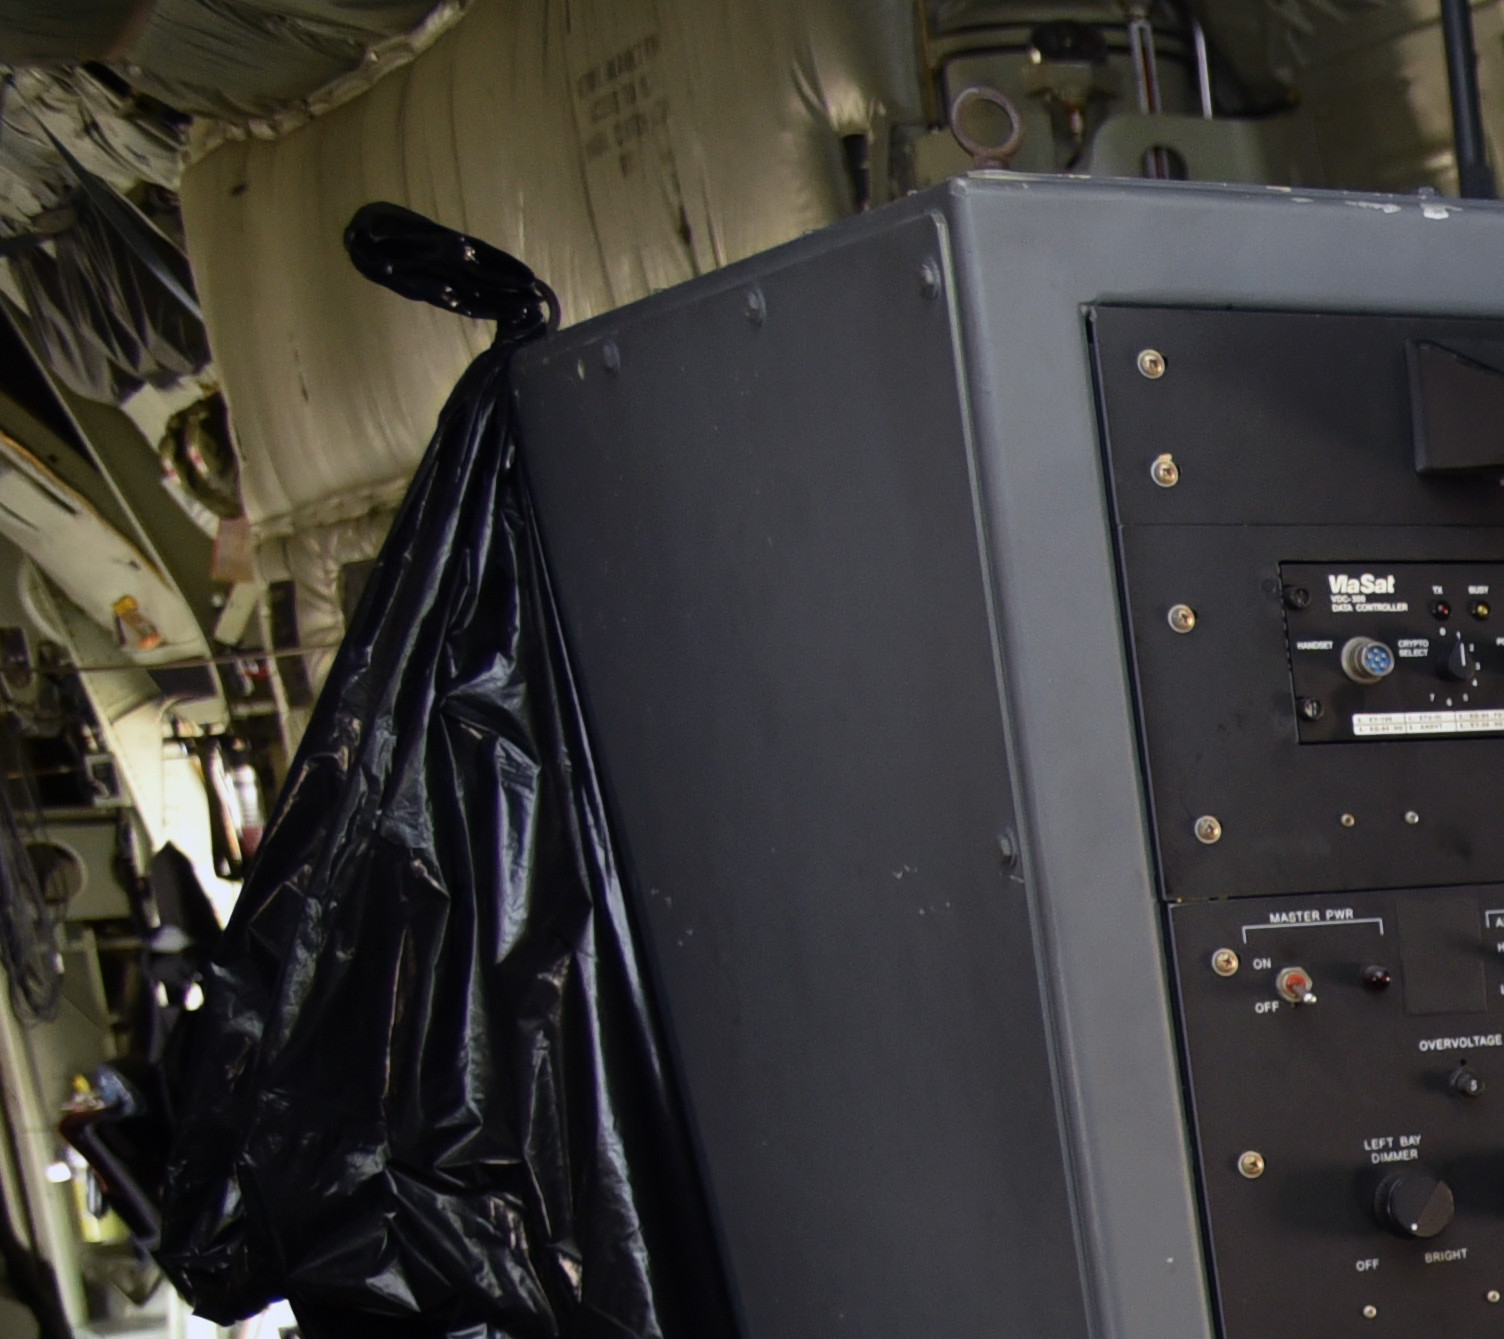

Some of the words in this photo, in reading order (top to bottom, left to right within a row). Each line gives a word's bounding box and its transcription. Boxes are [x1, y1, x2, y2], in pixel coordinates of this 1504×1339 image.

[1270, 911, 1320, 923] MASTER
[1326, 909, 1354, 920] PWR
[1253, 958, 1271, 970] ON
[1255, 1002, 1279, 1014] OFF
[1419, 1034, 1503, 1052] OVERVOLTAGE
[1364, 1137, 1395, 1151] LEFT
[1400, 1135, 1421, 1148] BAY
[1371, 1149, 1419, 1164] DIMMER
[1356, 1258, 1380, 1272] OFF
[1425, 1248, 1468, 1264] BRIGHT
